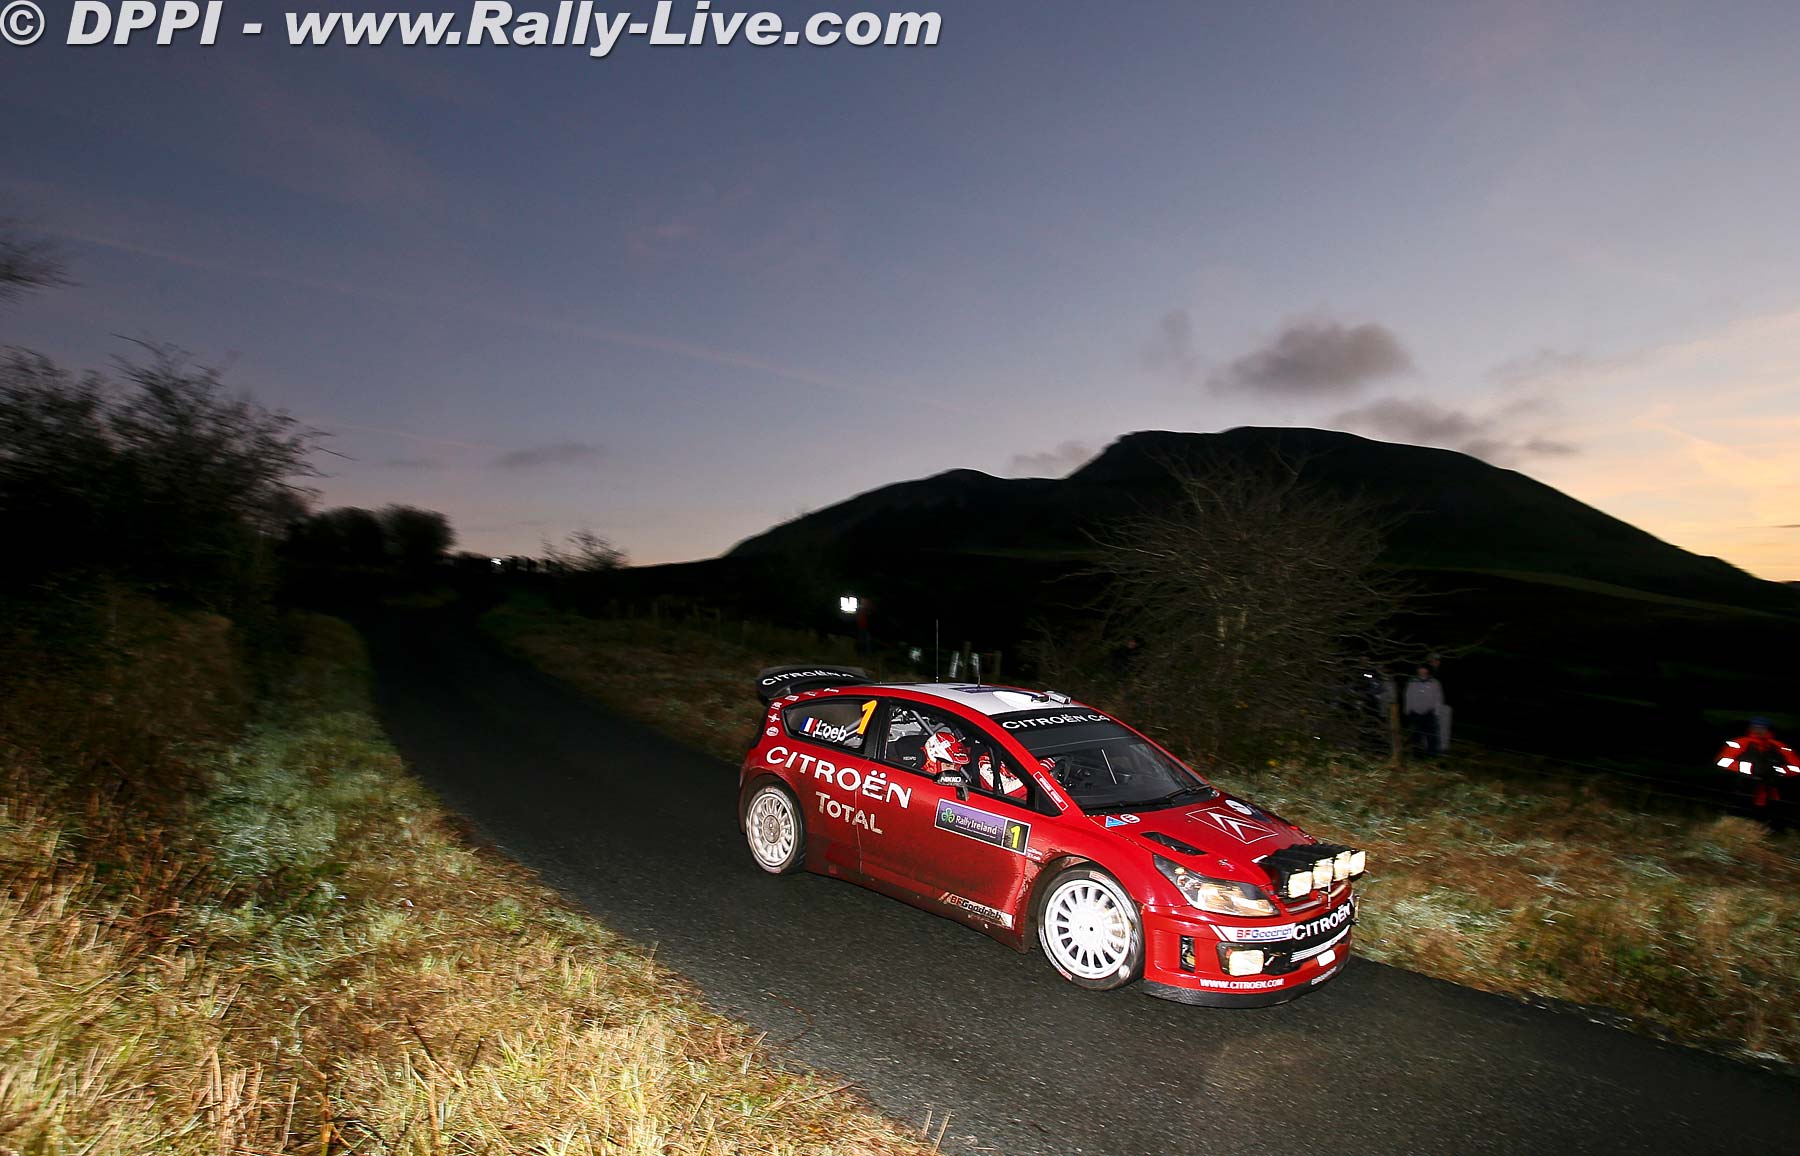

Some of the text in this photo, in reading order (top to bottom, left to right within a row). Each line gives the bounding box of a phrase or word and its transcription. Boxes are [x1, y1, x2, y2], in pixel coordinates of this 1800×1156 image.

[815, 719, 847, 743] Loeb
[857, 700, 878, 736] 1
[1002, 714, 1089, 729] CITROËN
[766, 746, 912, 809] CITROËN
[816, 790, 883, 835] TOTAL
[955, 815, 972, 829] Rally
[971, 820, 998, 835] Ireland
[1010, 825, 1021, 849] 1
[1292, 902, 1351, 940] CITROËN
